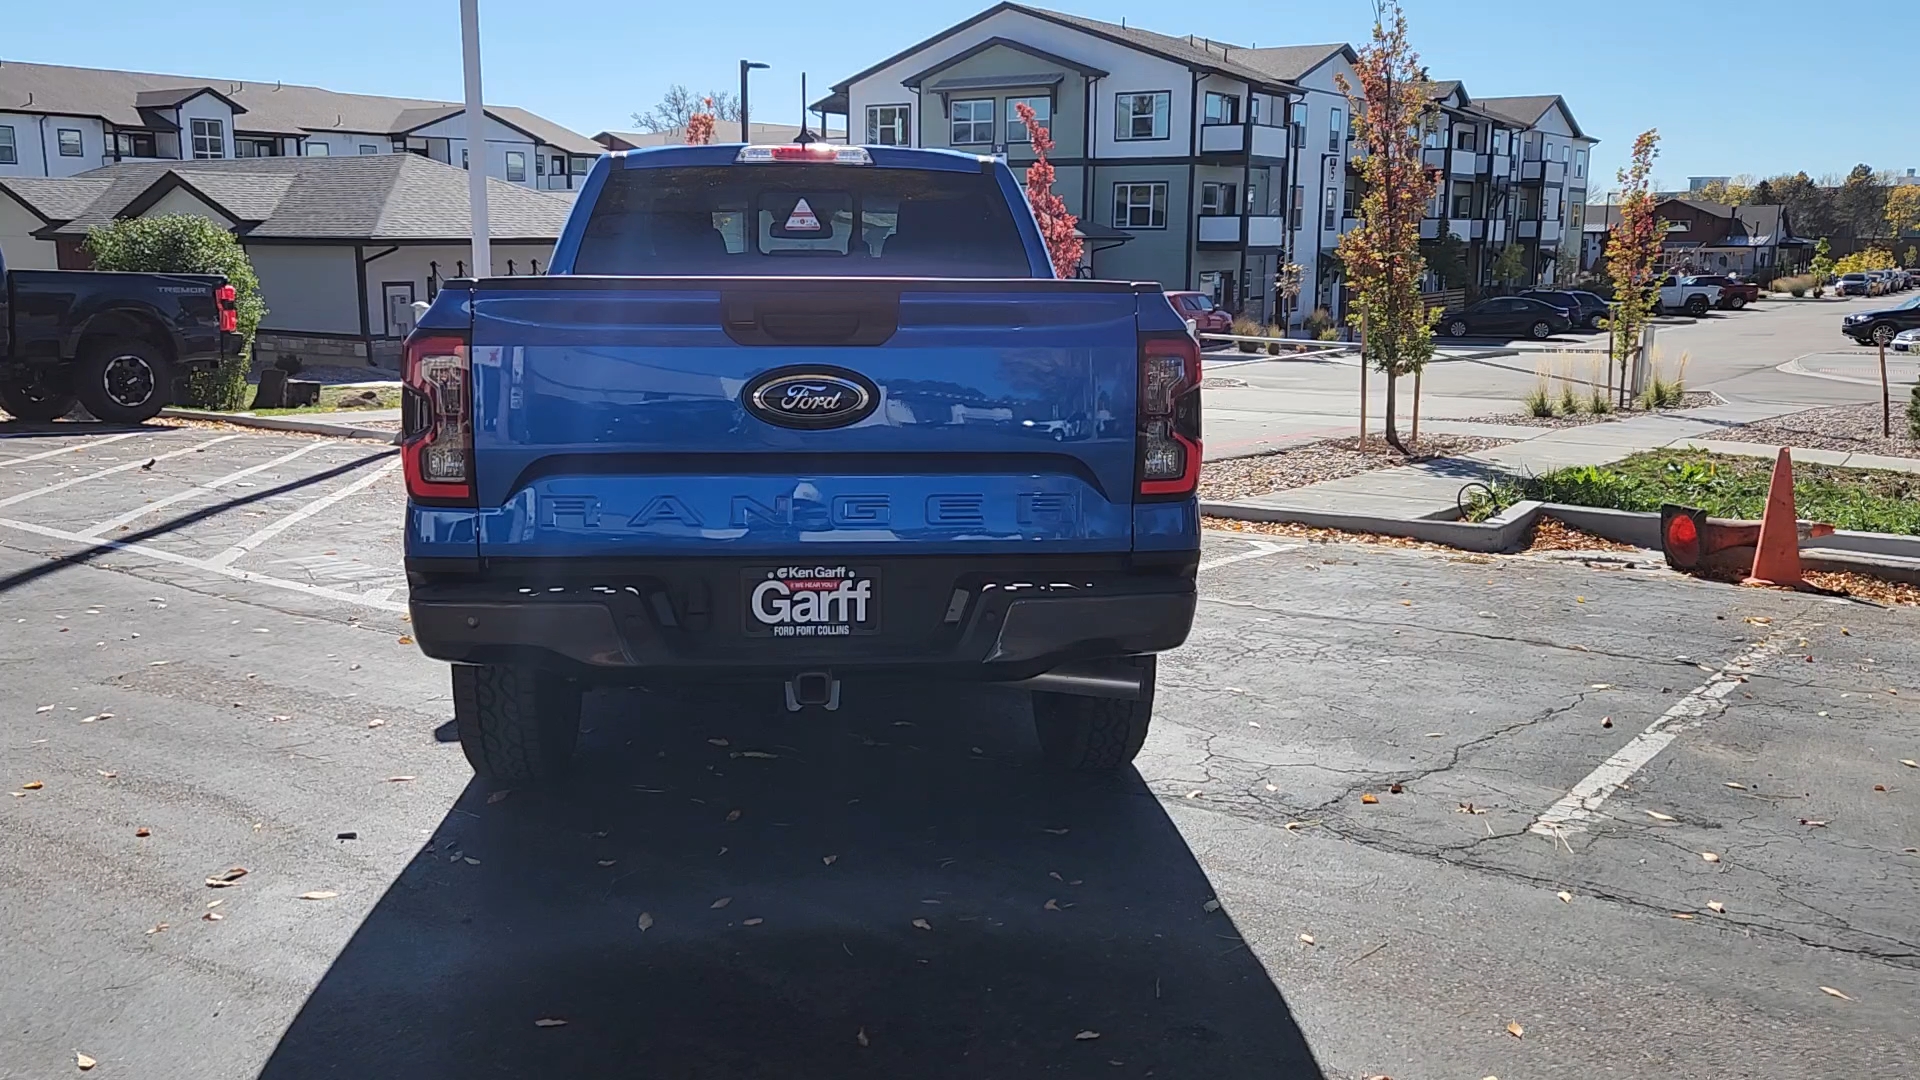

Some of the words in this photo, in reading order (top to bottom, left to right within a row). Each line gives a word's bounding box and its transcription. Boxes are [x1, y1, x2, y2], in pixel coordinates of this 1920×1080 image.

[781, 384, 842, 409] Ford
[540, 492, 1077, 528] RANGER
[789, 567, 814, 578] Ken
[815, 567, 846, 578] Garff
[752, 580, 871, 624] Garff
[774, 626, 795, 636] FORD
[796, 626, 816, 636] FORT
[817, 625, 850, 635] COLLINS
